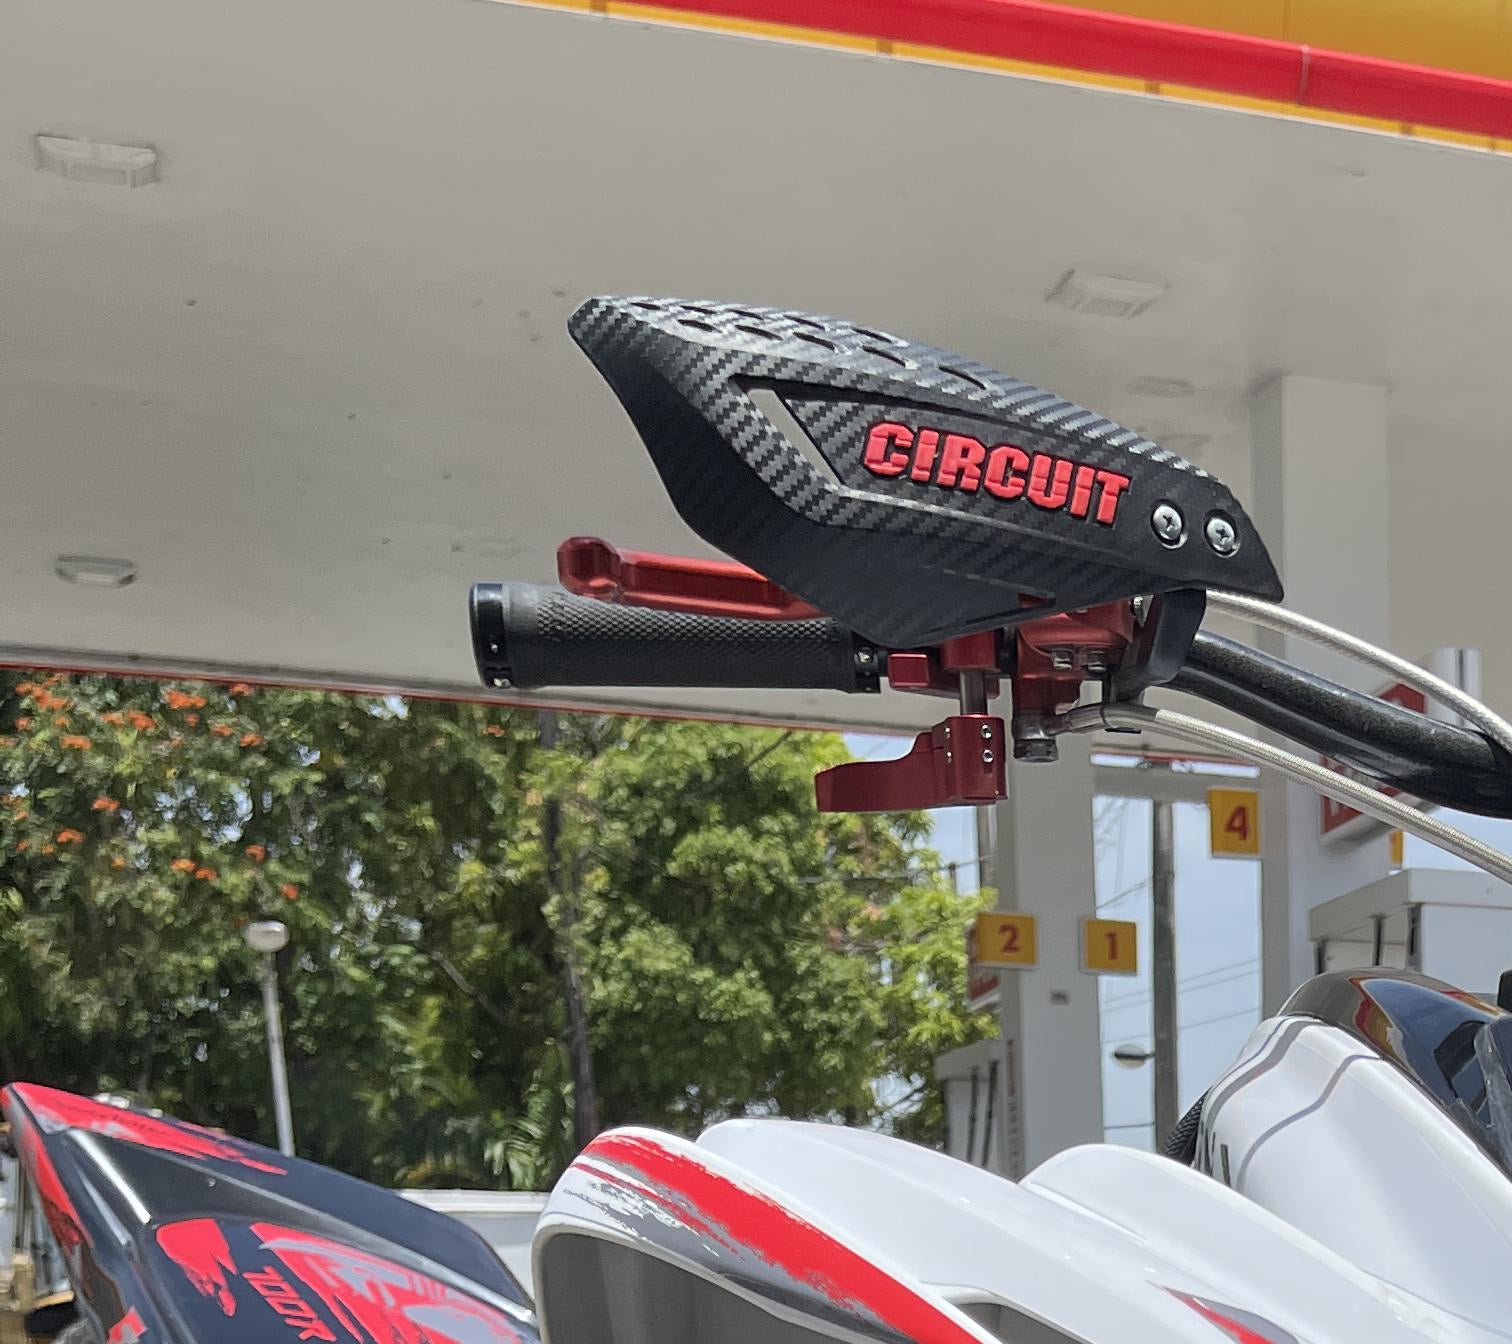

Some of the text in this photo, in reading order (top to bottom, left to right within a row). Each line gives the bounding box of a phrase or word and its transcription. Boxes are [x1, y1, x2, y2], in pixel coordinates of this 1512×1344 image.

[863, 421, 1131, 526] CIRCUIT
[1224, 805, 1252, 842] 4
[998, 923, 1020, 953] 2
[1105, 931, 1119, 961] 1
